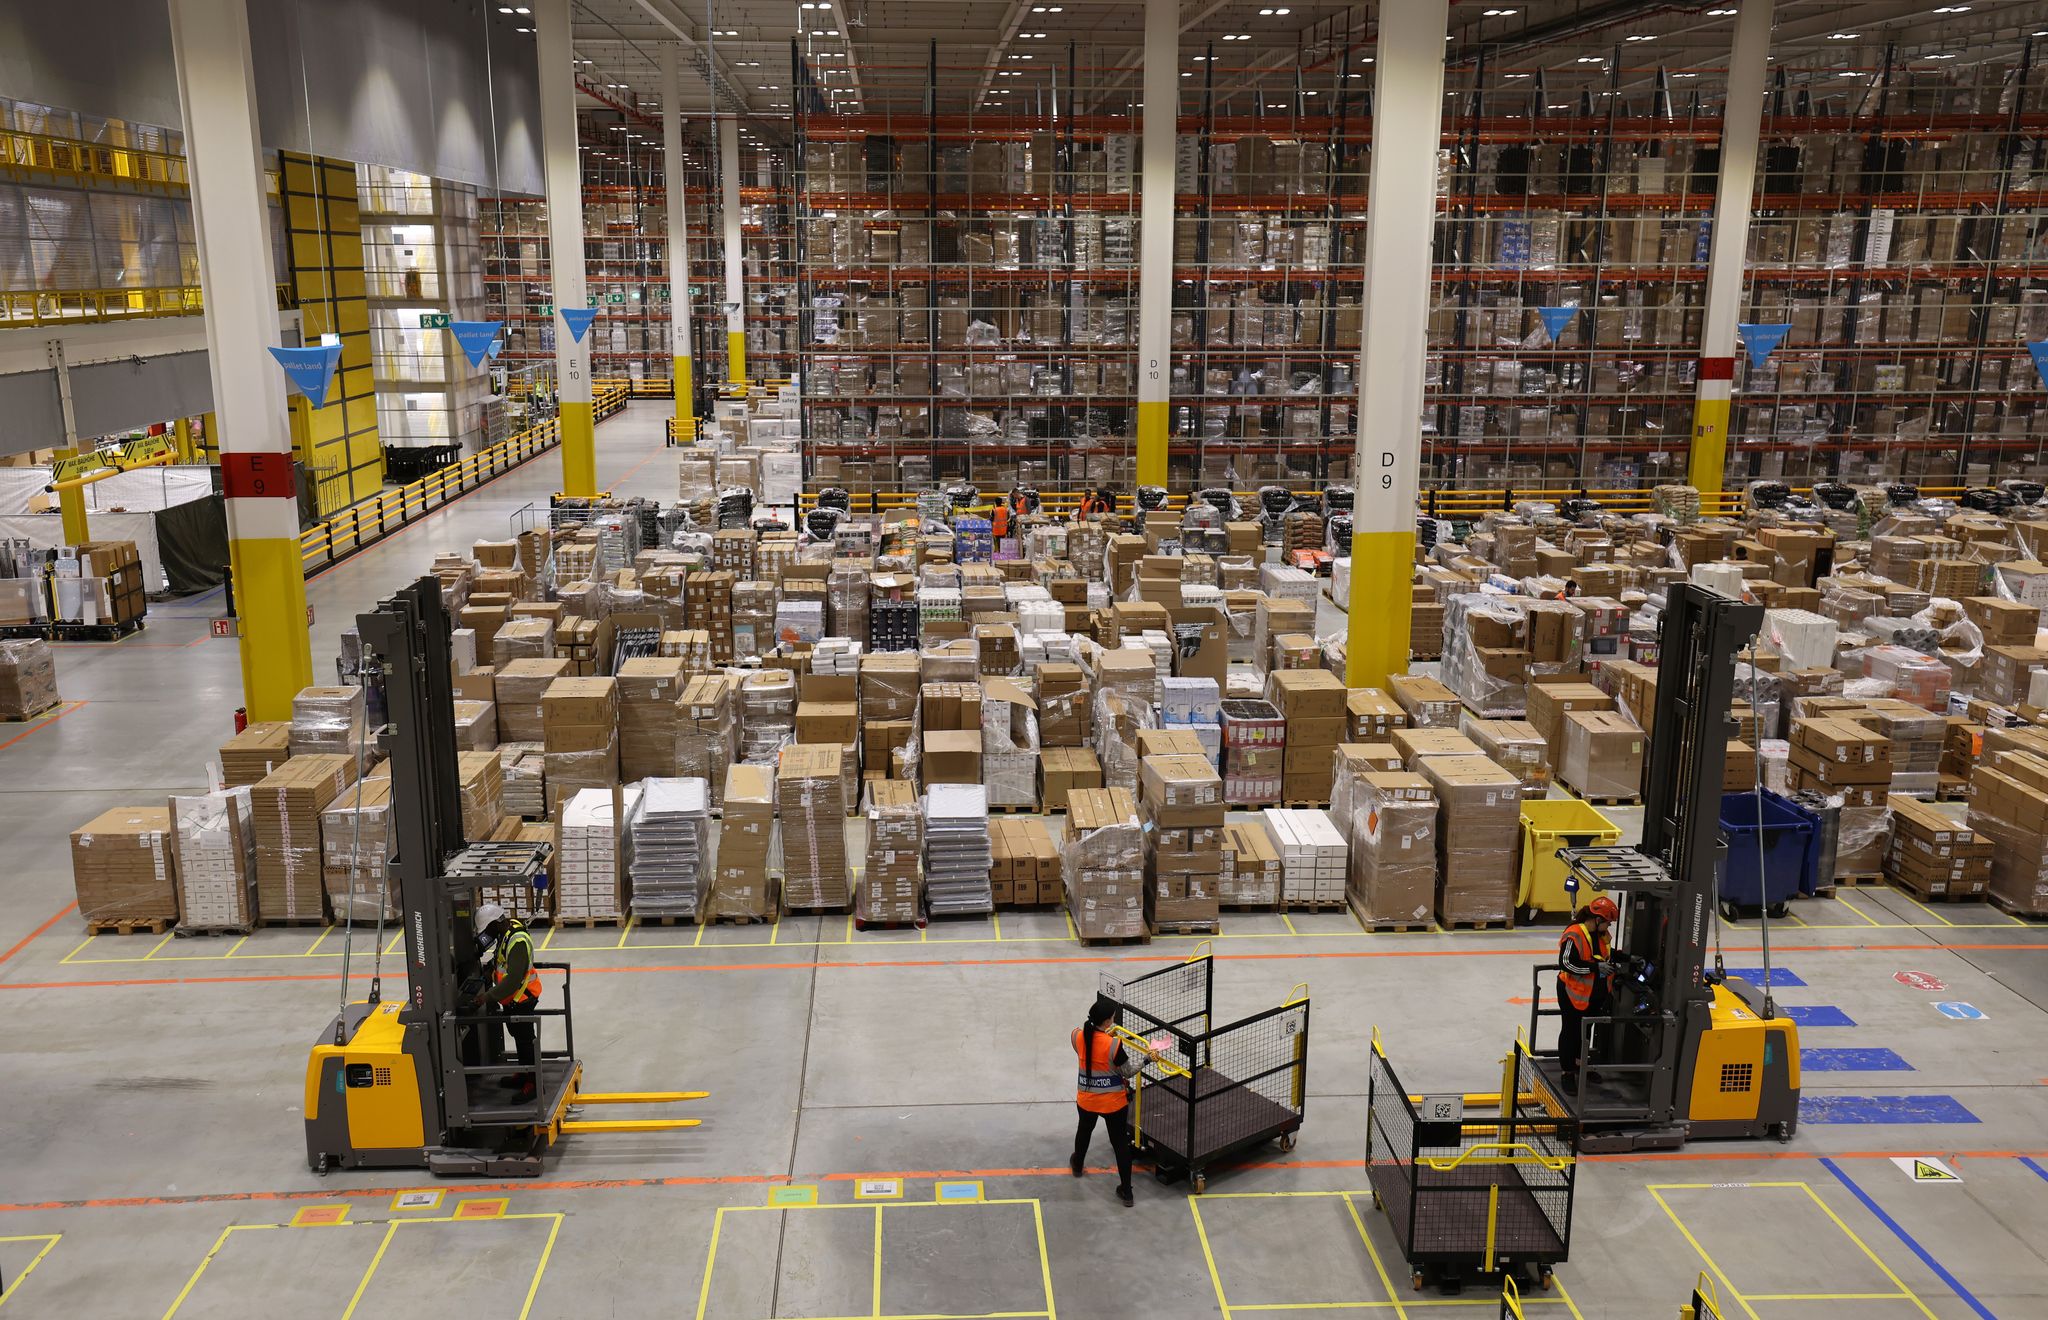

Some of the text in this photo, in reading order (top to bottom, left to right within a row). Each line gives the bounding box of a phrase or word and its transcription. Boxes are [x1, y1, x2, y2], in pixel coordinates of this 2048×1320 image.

[458, 331, 479, 340] pallet
[303, 361, 322, 370] land
[570, 359, 577, 368] E
[1150, 359, 1158, 368] D
[568, 371, 580, 380] 10
[1149, 370, 1159, 380] 10
[251, 456, 264, 471] E
[1382, 452, 1395, 467] D
[254, 479, 265, 494] 9
[1382, 474, 1392, 489] 9
[1692, 893, 1703, 947] JUNGHEINRICH
[414, 911, 426, 967] JUNGHEINRICH
[1079, 1076, 1112, 1087] NSRUCTOR
